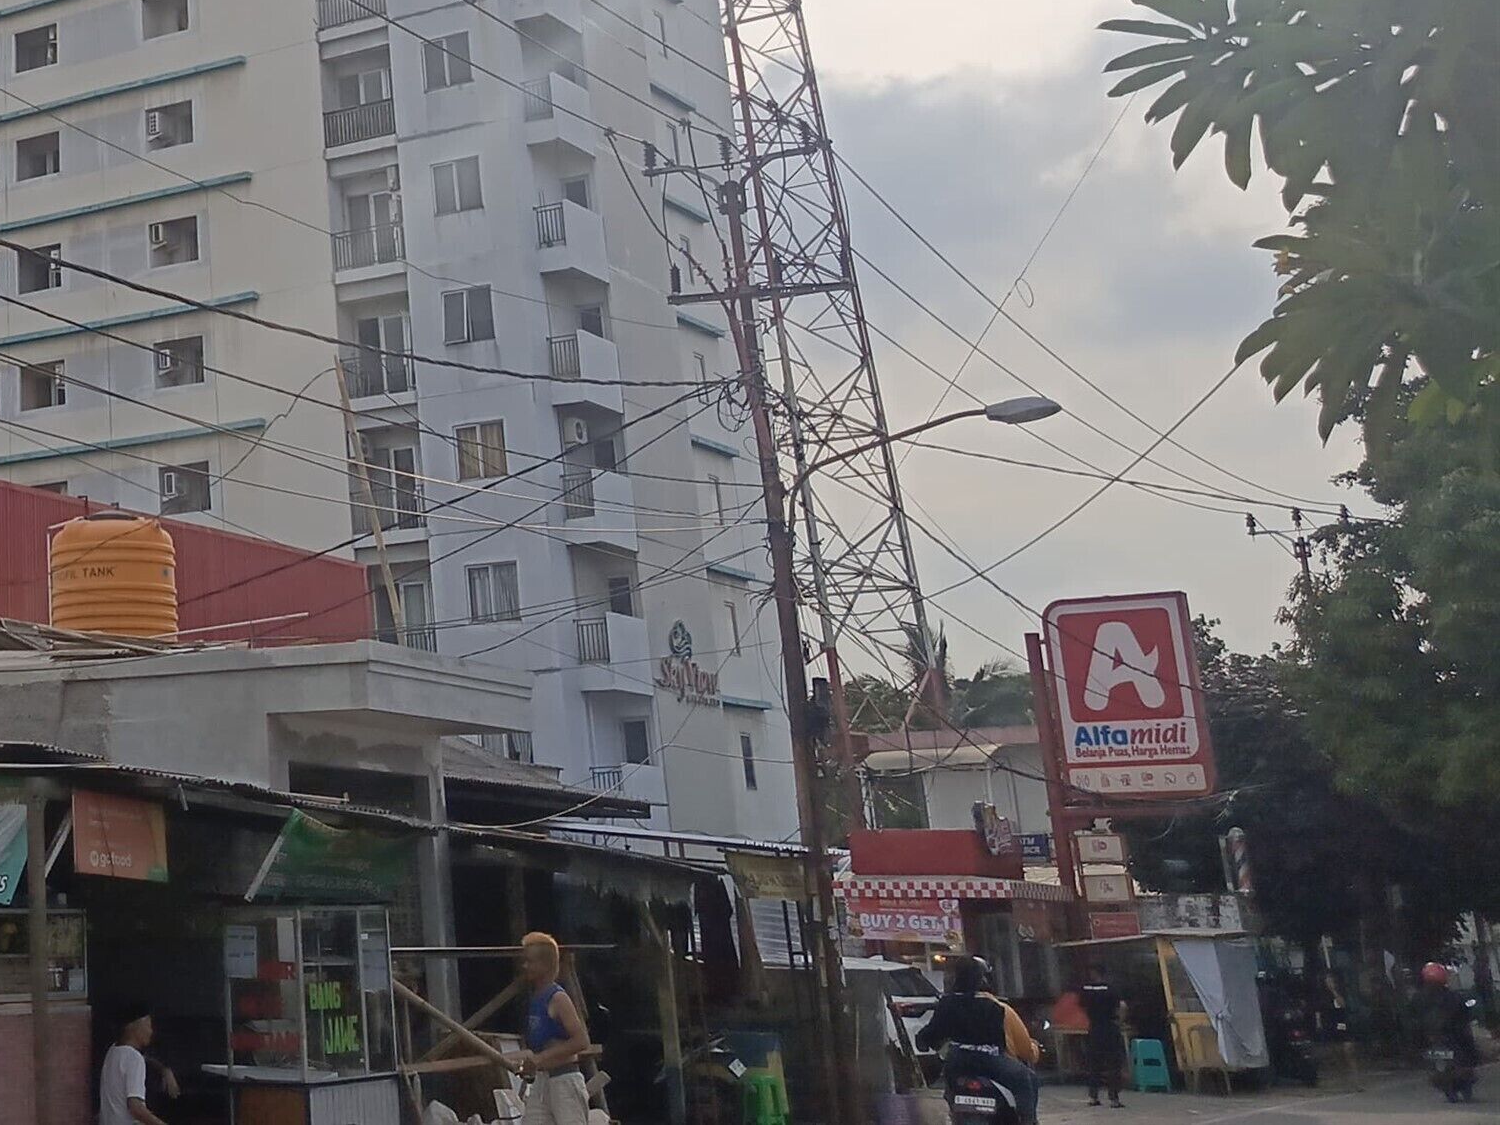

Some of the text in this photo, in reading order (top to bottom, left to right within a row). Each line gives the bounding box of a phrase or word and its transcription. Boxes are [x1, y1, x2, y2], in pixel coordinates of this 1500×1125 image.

[82, 567, 115, 578] TANK
[1075, 722, 1187, 747] Alfamidi
[1076, 747, 1107, 760] Belanja
[1131, 745, 1158, 759] Harga
[859, 913, 892, 929] BUY
[896, 914, 905, 929] 2
[909, 915, 938, 930] GET
[308, 981, 341, 1010] BANG
